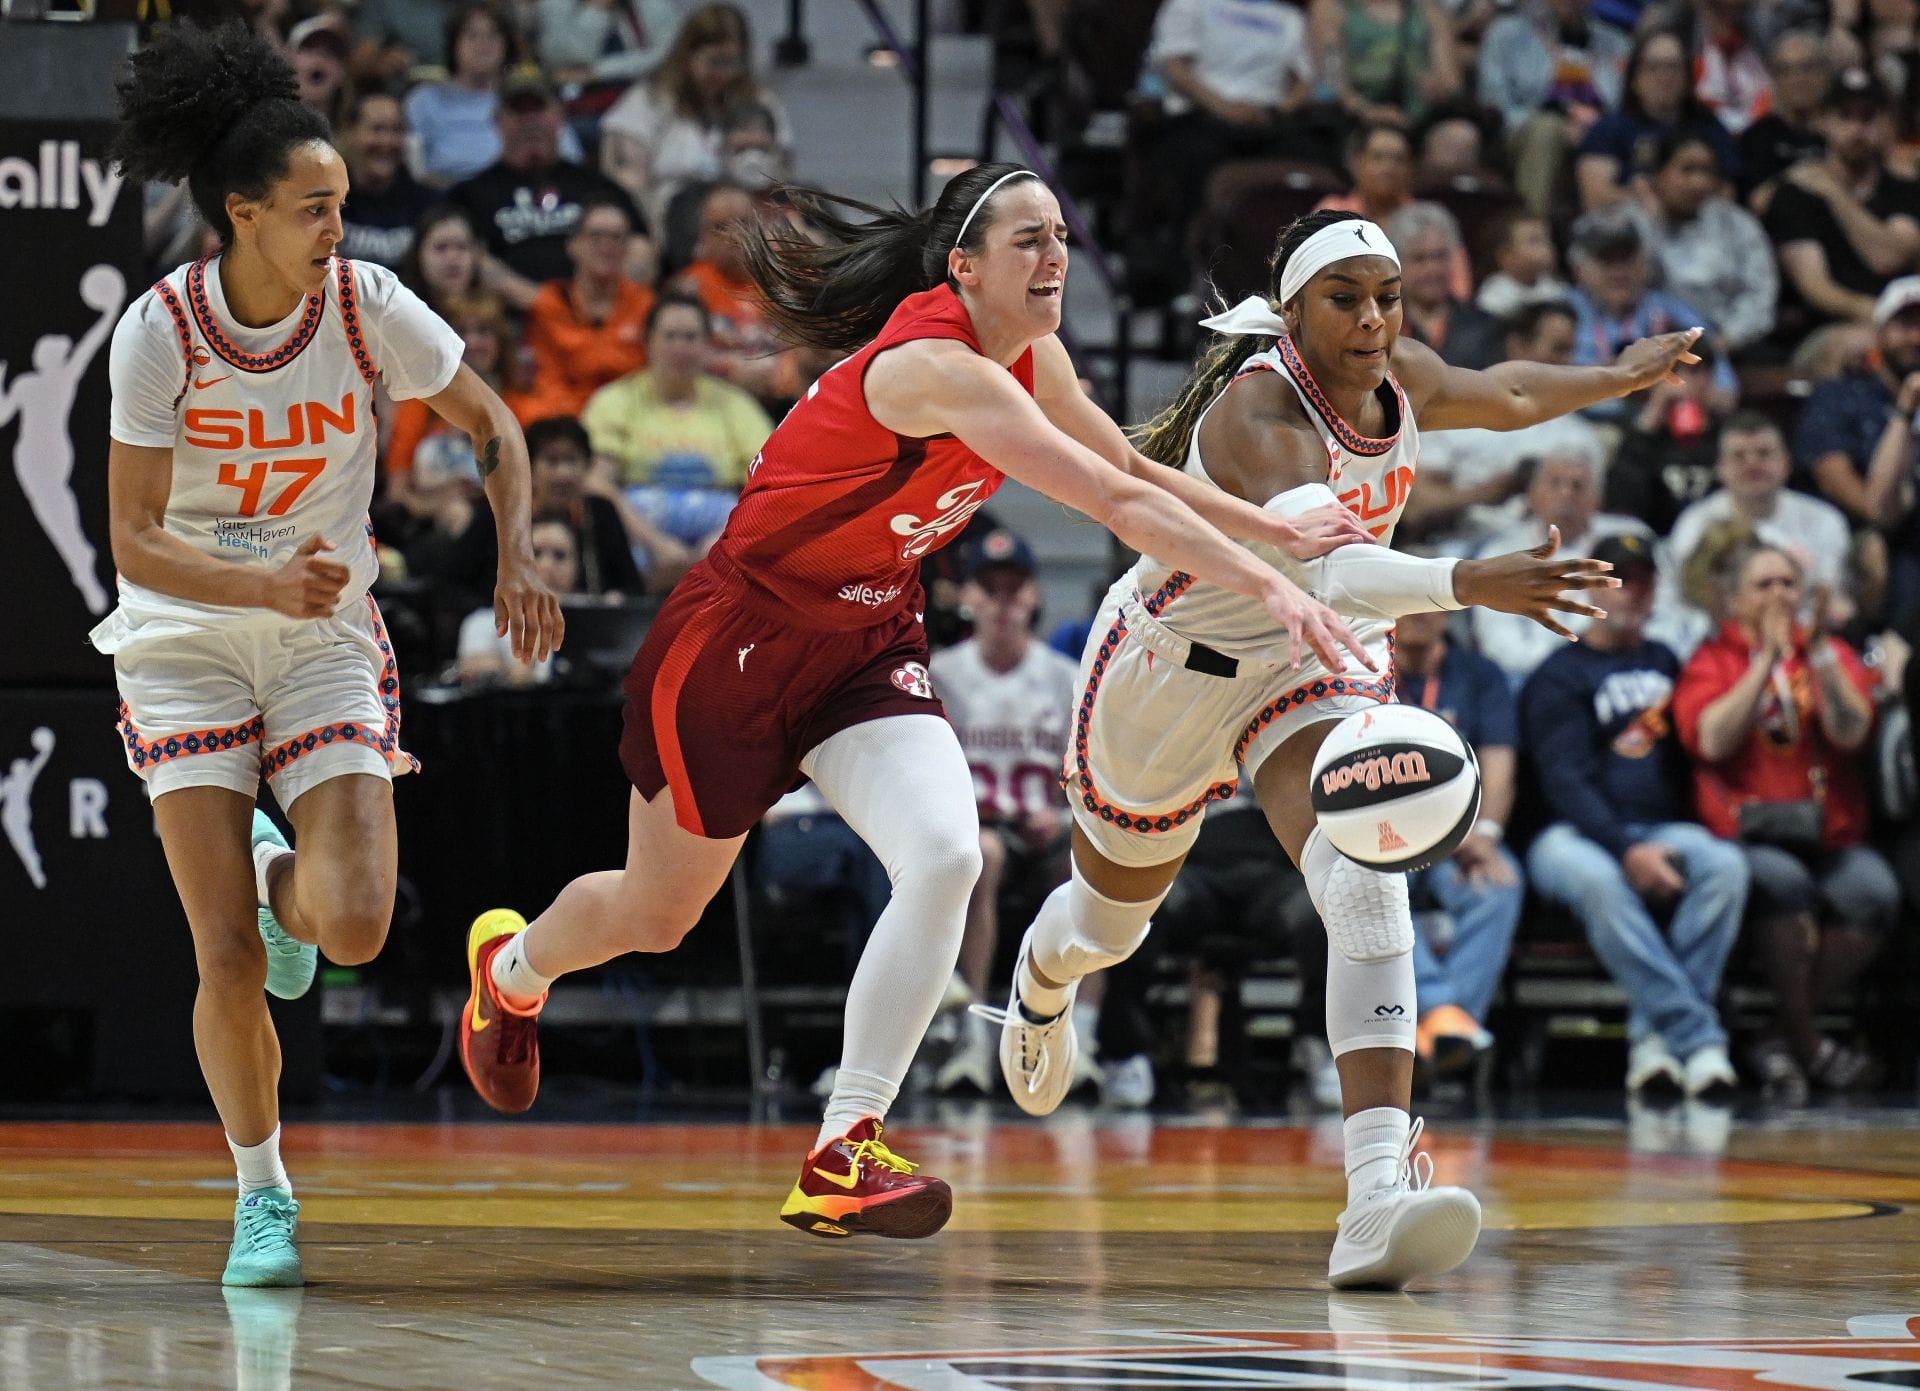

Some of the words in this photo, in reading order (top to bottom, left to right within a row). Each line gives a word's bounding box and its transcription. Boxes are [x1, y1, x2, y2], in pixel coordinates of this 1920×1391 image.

[0, 139, 124, 227] ally
[184, 391, 356, 450] SUN
[216, 457, 327, 518] 47
[218, 534, 268, 558] Health
[1321, 751, 1431, 796] Wilson
